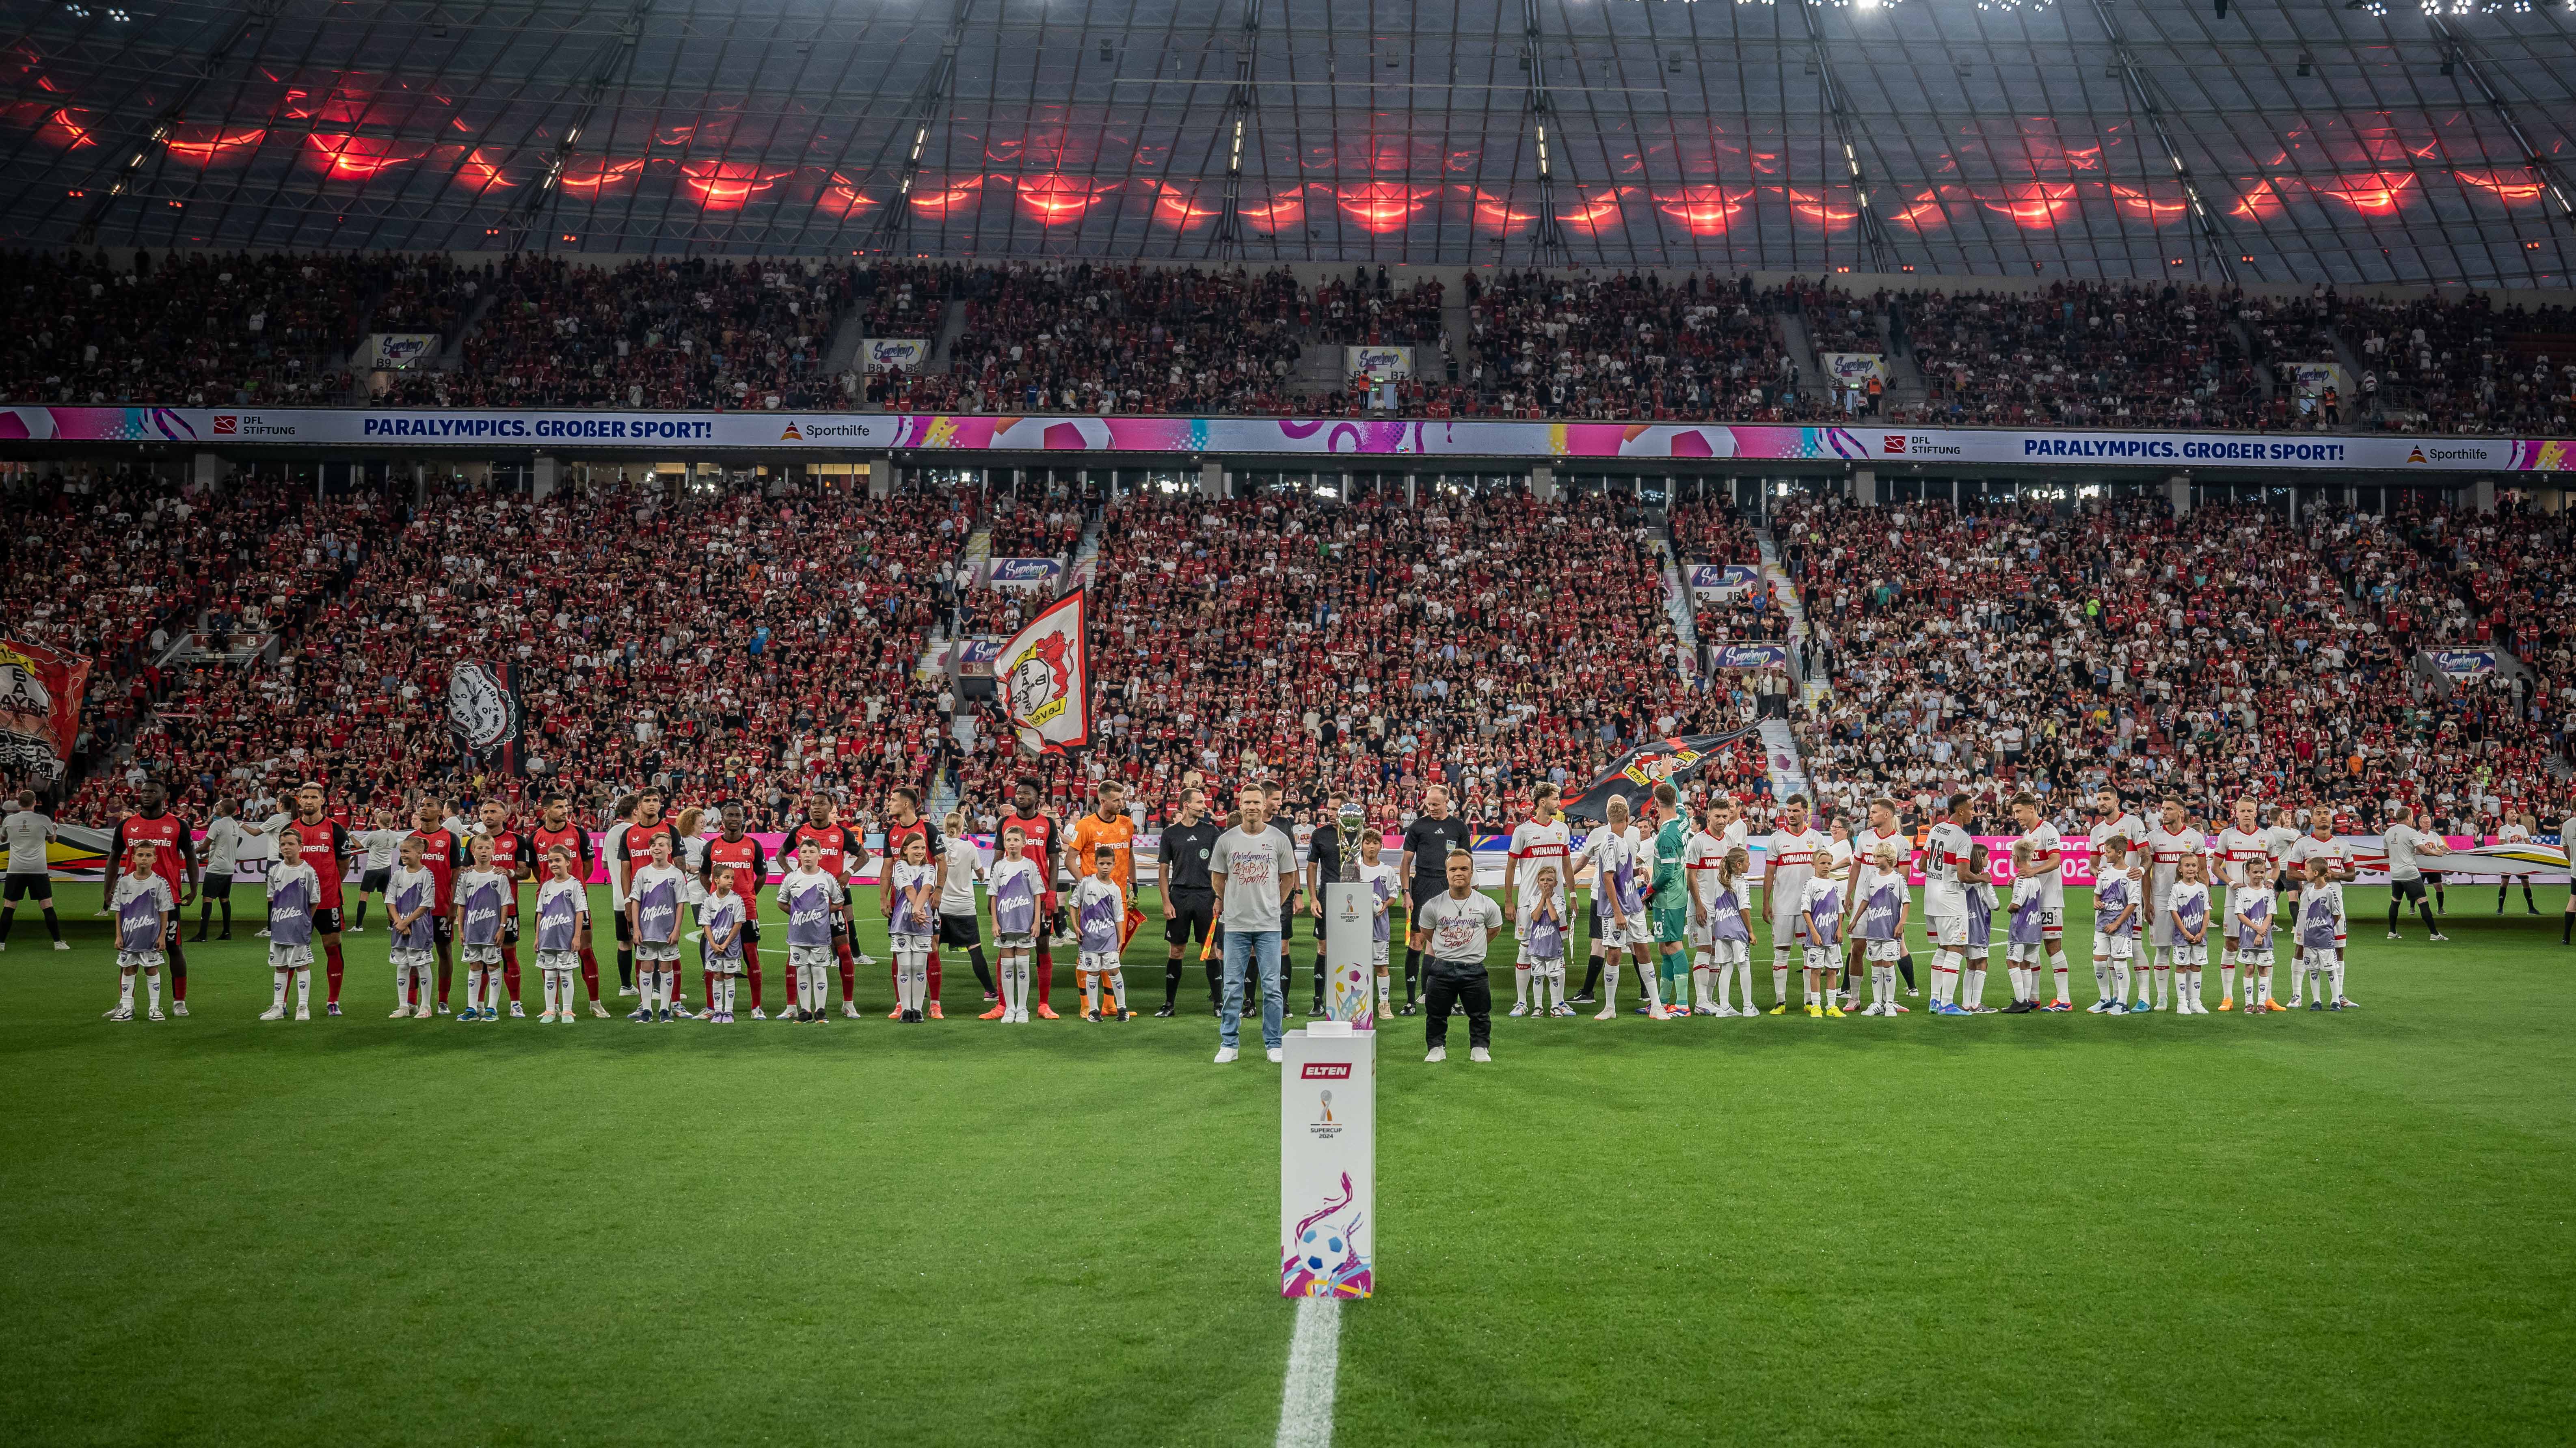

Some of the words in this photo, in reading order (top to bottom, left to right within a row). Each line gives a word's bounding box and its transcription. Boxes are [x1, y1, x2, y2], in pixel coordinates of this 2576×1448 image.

[376, 358, 391, 367] B9
[1358, 349, 1399, 368] Supercup
[1833, 356, 1873, 374] Supercup
[244, 416, 264, 425] DFL
[364, 418, 531, 436] PARALYMPICS.
[631, 421, 712, 439] SPORT!
[243, 426, 296, 435] STIFTUNG
[806, 421, 870, 438] Sporthilfe
[1912, 436, 1930, 444] DFL
[1912, 446, 1960, 454] STIFTUNG
[2024, 439, 2179, 457] PARALYMPICS.
[2270, 443, 2345, 461] SPORT!
[2429, 448, 2487, 462] Sporthilfe
[1005, 560, 1048, 580] Supercup
[1725, 647, 1770, 667] Supercup
[2438, 652, 2481, 672] Supercup
[630, 848, 650, 858] Barm
[820, 847, 838, 856] enia
[1782, 854, 1813, 864] WINAMA
[1928, 838, 1944, 871] 18
[2232, 851, 2267, 861] WINAMAX
[641, 904, 673, 921] Milka
[998, 895, 1031, 914] Milka
[270, 906, 303, 923] Milka
[467, 907, 497, 924] Milka
[539, 913, 572, 931] Milka
[792, 909, 823, 926] Milka
[1869, 906, 1893, 921] Milka
[2041, 911, 2054, 925] 29
[122, 915, 156, 933] Milka
[166, 921, 177, 934] 2
[506, 917, 518, 931] 24
[1305, 1066, 1347, 1075] ELTEN
